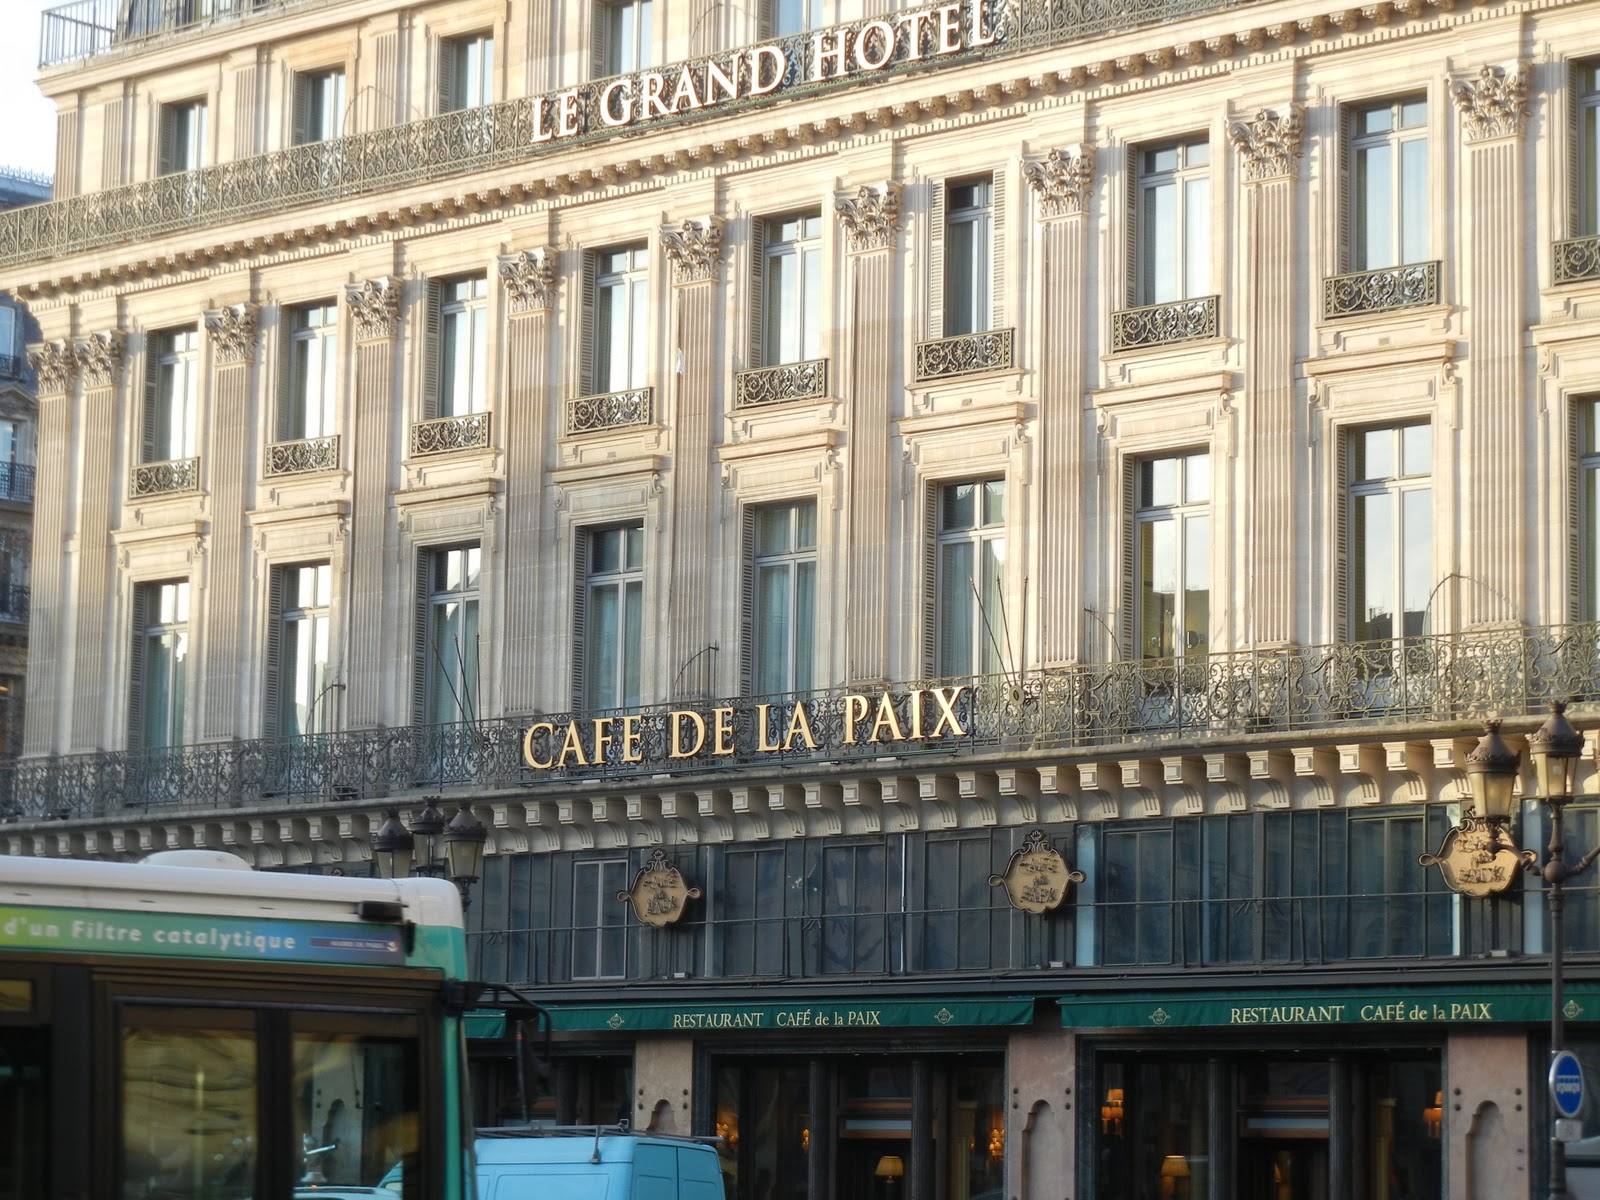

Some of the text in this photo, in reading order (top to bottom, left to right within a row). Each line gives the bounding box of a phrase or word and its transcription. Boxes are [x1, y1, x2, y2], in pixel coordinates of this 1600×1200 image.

[531, 0, 996, 143] LE GRAND HOTEL
[523, 686, 967, 770] CAFE DE LA PAIX
[4, 917, 297, 953] d'un Filtre catalytique
[673, 1009, 881, 1028] RESTAURANT CAFÉ de la PAIX
[1230, 1001, 1493, 1024] RESTAURANT CAFÉ de la PAIX
